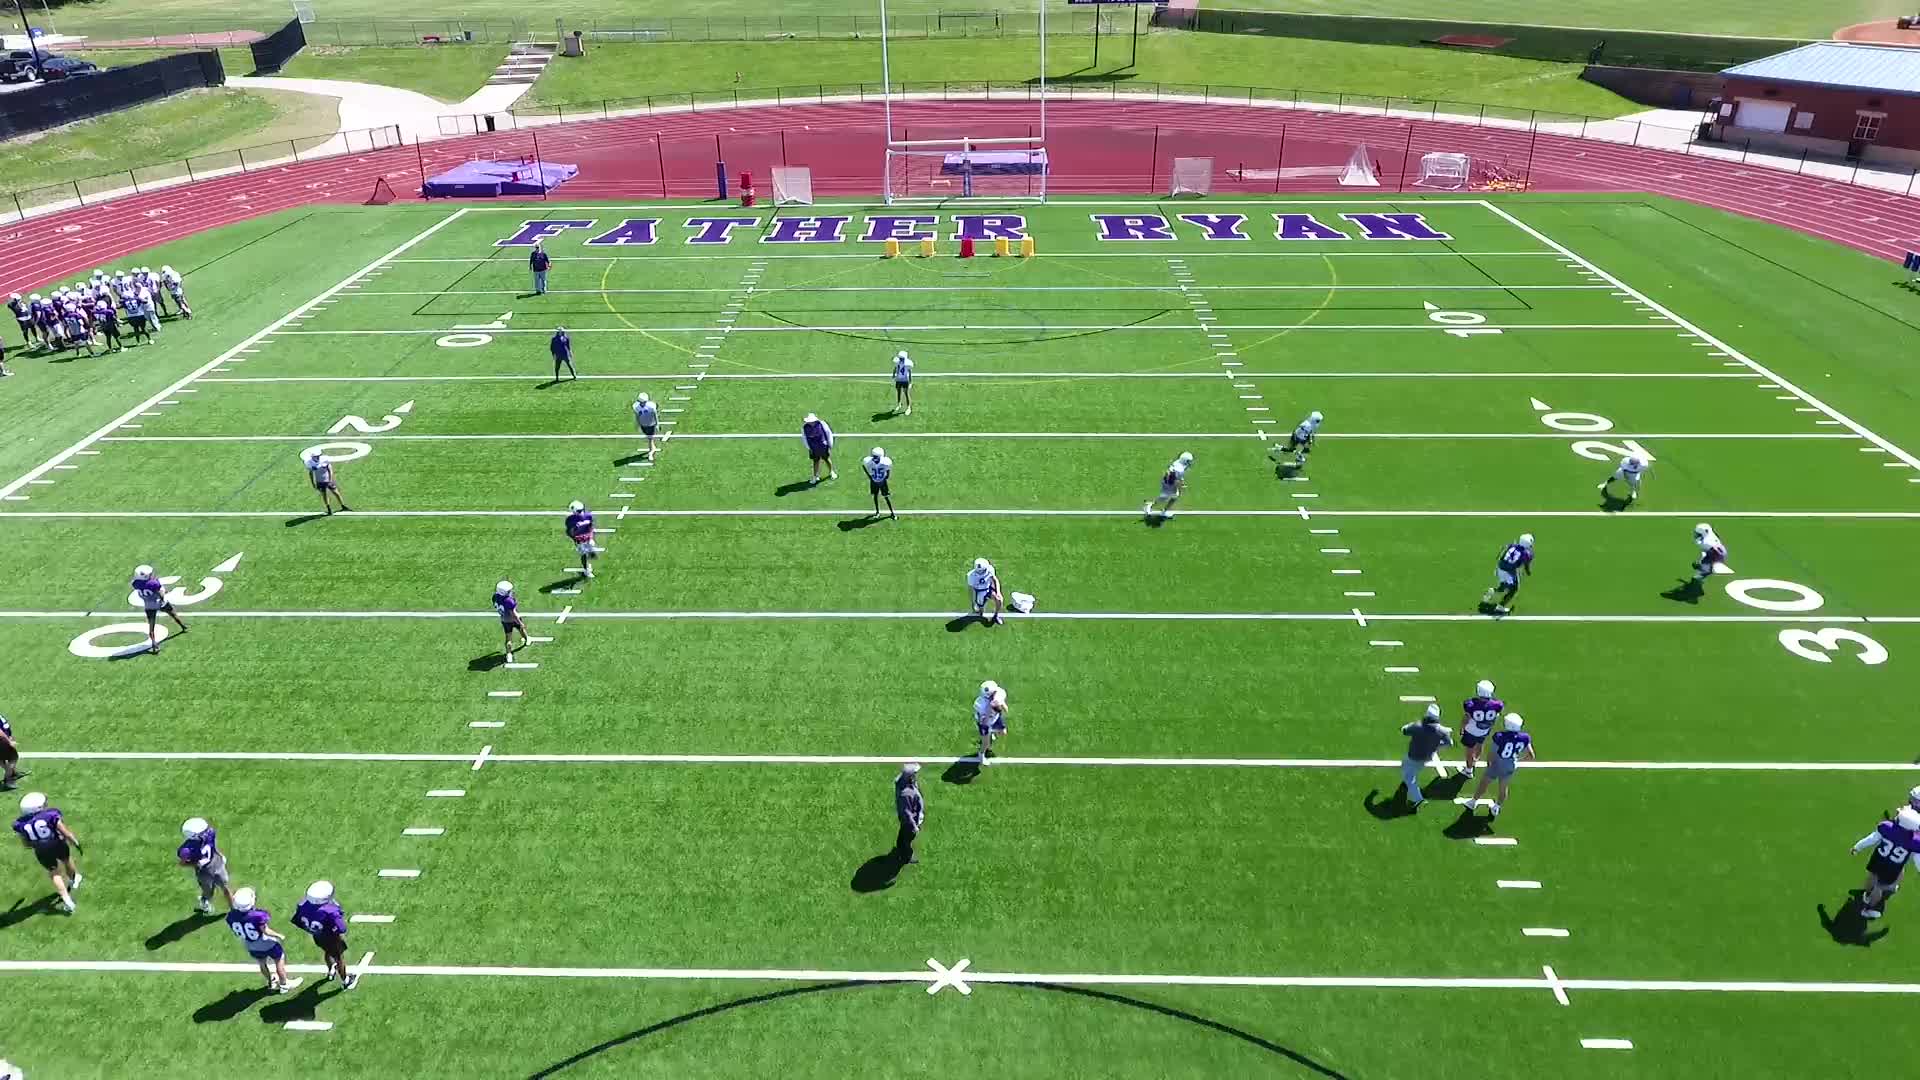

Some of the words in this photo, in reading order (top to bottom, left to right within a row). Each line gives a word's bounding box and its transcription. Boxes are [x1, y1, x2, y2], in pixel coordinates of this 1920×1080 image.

[492, 214, 1028, 247] FATHER
[1089, 213, 1451, 241] RYAN
[436, 320, 507, 347] 10
[1428, 311, 1504, 338] 10
[299, 415, 402, 463] 20
[1539, 412, 1657, 462] 20
[67, 576, 224, 658] 30
[1723, 578, 1890, 665] 30
[24, 819, 50, 841] 16
[1877, 838, 1909, 864] 39
